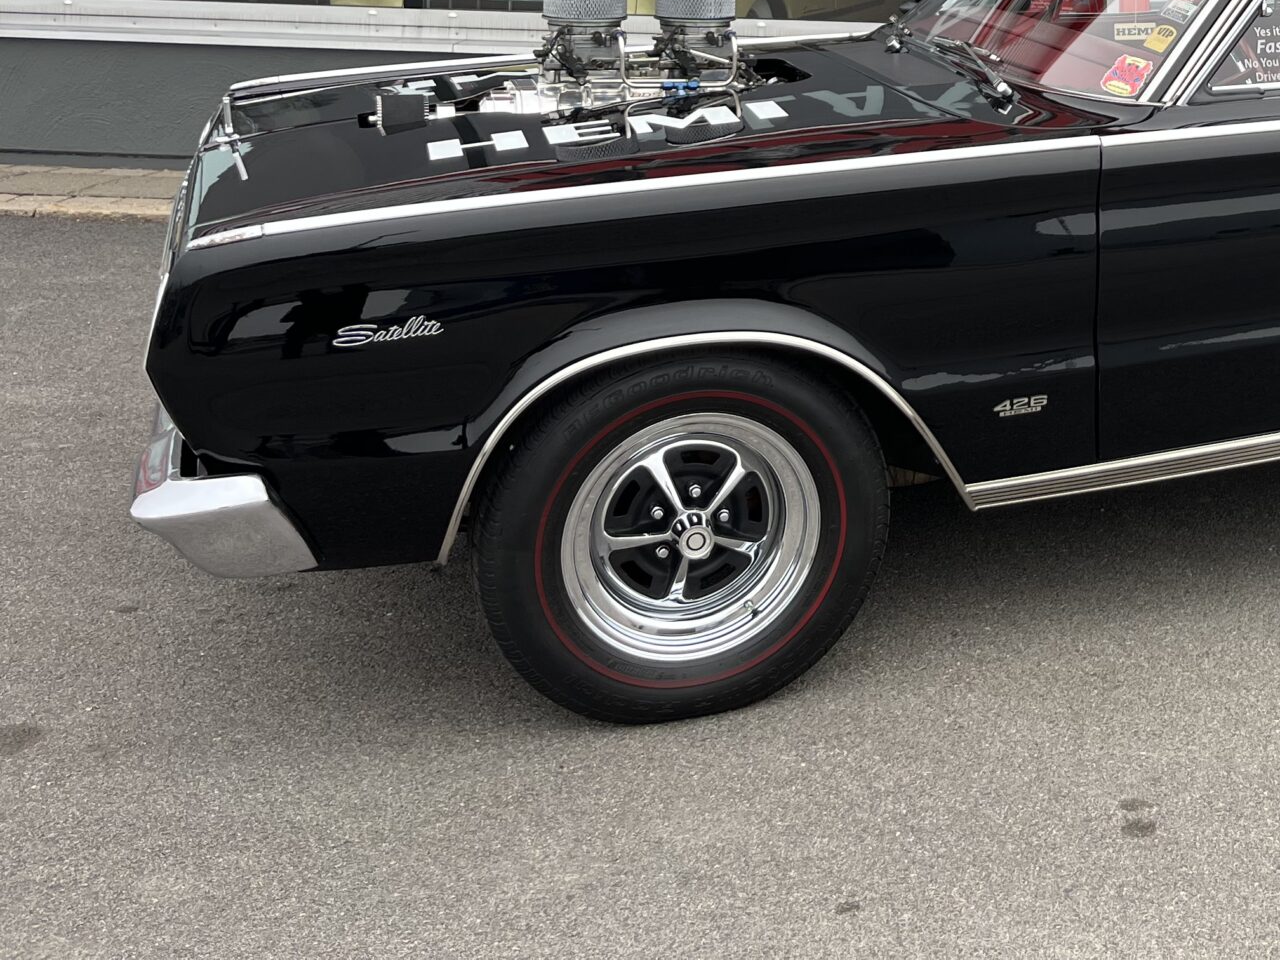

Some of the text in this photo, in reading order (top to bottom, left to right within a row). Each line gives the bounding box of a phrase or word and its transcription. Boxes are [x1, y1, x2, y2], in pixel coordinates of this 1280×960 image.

[1157, 27, 1174, 38] VIP
[1254, 26, 1271, 37] Yes
[1244, 58, 1259, 69] No
[1260, 57, 1280, 68] You
[332, 315, 444, 347] Satellite
[993, 394, 1048, 412] 426
